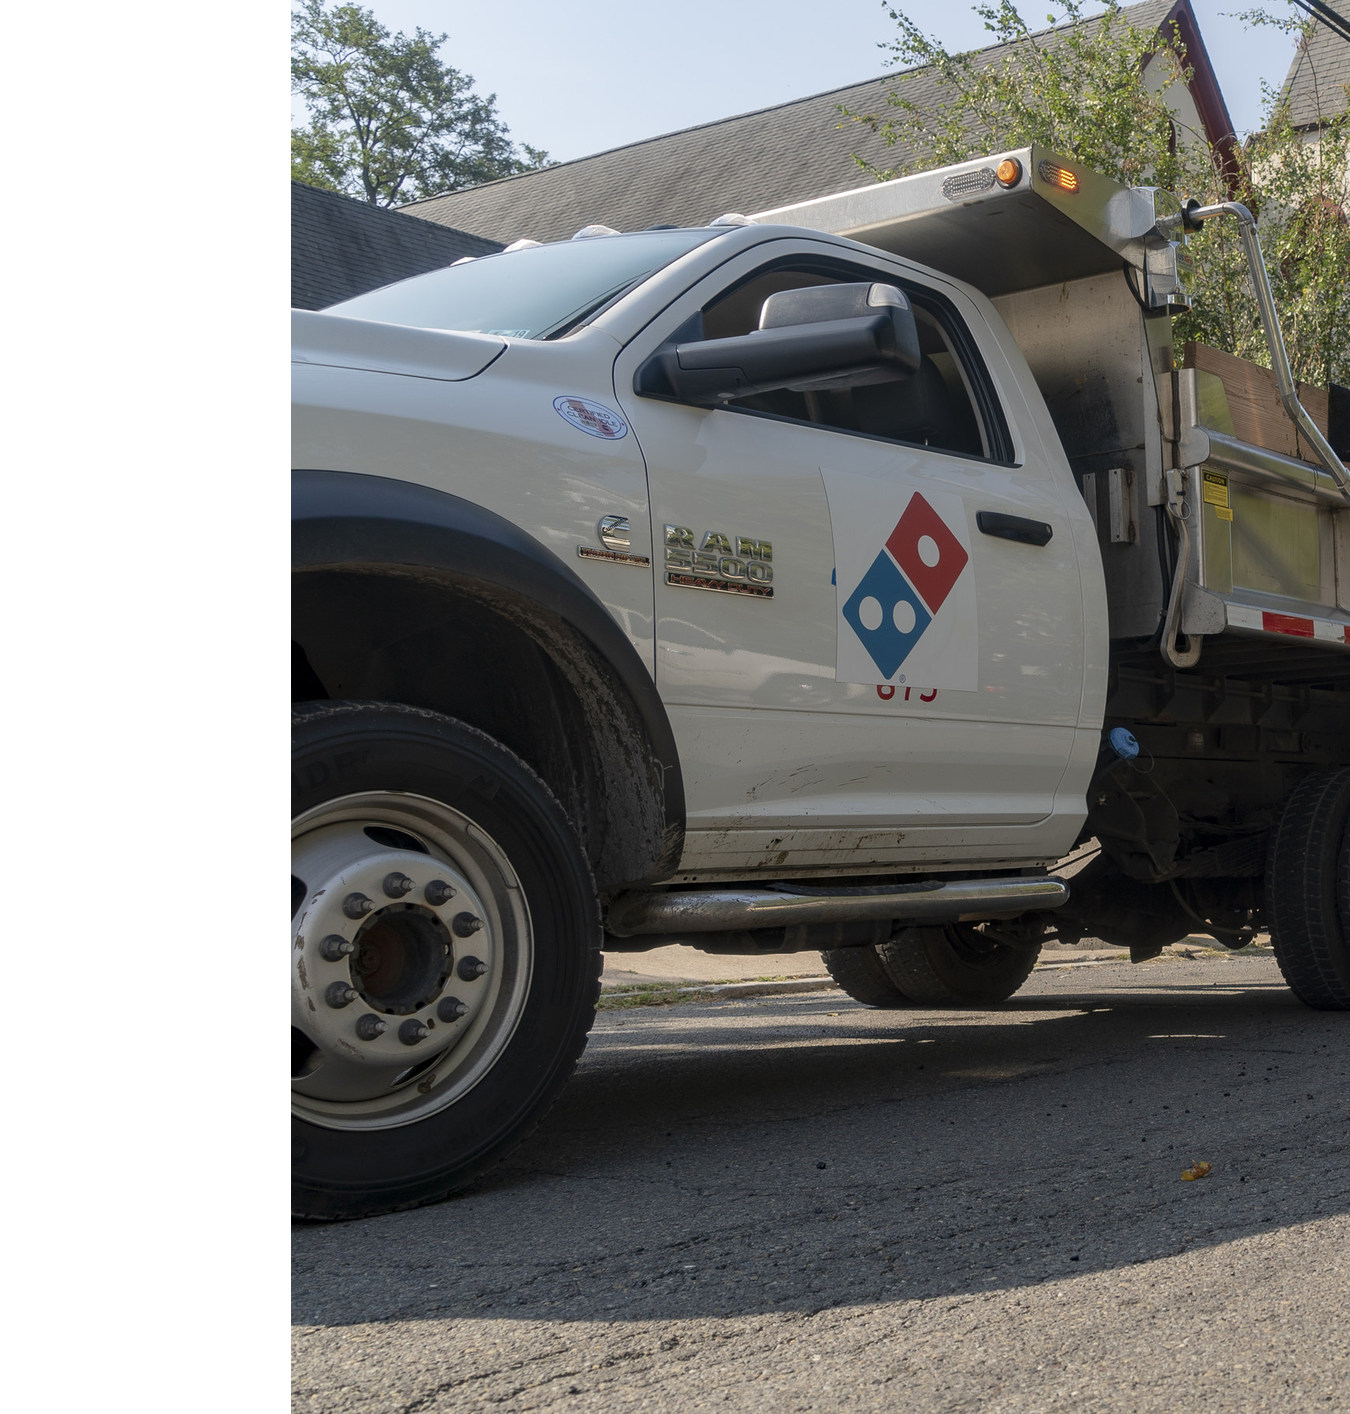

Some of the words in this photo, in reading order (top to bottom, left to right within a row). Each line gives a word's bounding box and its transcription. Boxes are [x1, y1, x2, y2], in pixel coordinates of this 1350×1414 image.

[566, 411, 596, 423] CLEAN
[567, 405, 611, 420] CERTIFIED
[663, 523, 773, 562] RAM
[664, 547, 774, 584] 5500
[670, 573, 726, 589] HEAVY
[727, 582, 772, 596] DUTY
